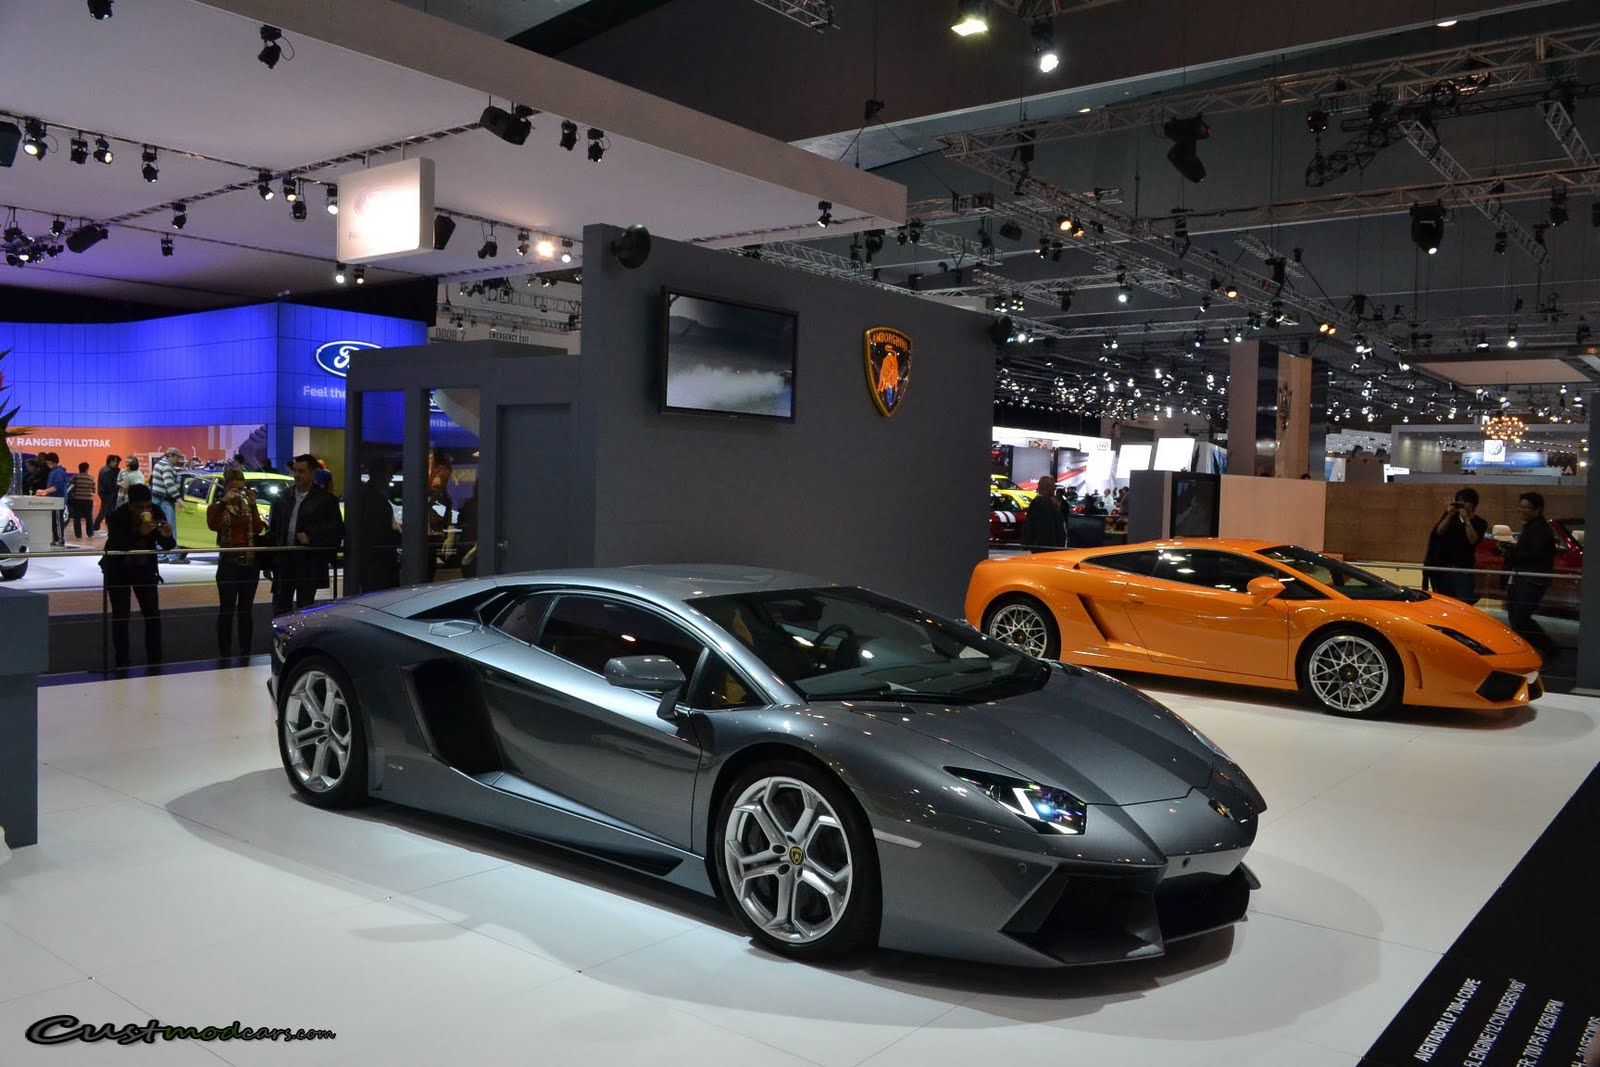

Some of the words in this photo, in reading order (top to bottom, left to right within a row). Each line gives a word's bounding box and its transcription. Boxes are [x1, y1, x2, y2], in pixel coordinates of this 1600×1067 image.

[303, 385, 328, 397] Feel
[17, 438, 62, 447] RANGER
[64, 439, 111, 448] WILDTRAK
[1543, 998, 1565, 1015] RPM
[1413, 1019, 1454, 1063] AVENTADOR
[1440, 1011, 1458, 1023] LP
[1456, 977, 1482, 999] COUPE
[1534, 1026, 1552, 1038] AT
[1528, 1035, 1548, 1047] PS
